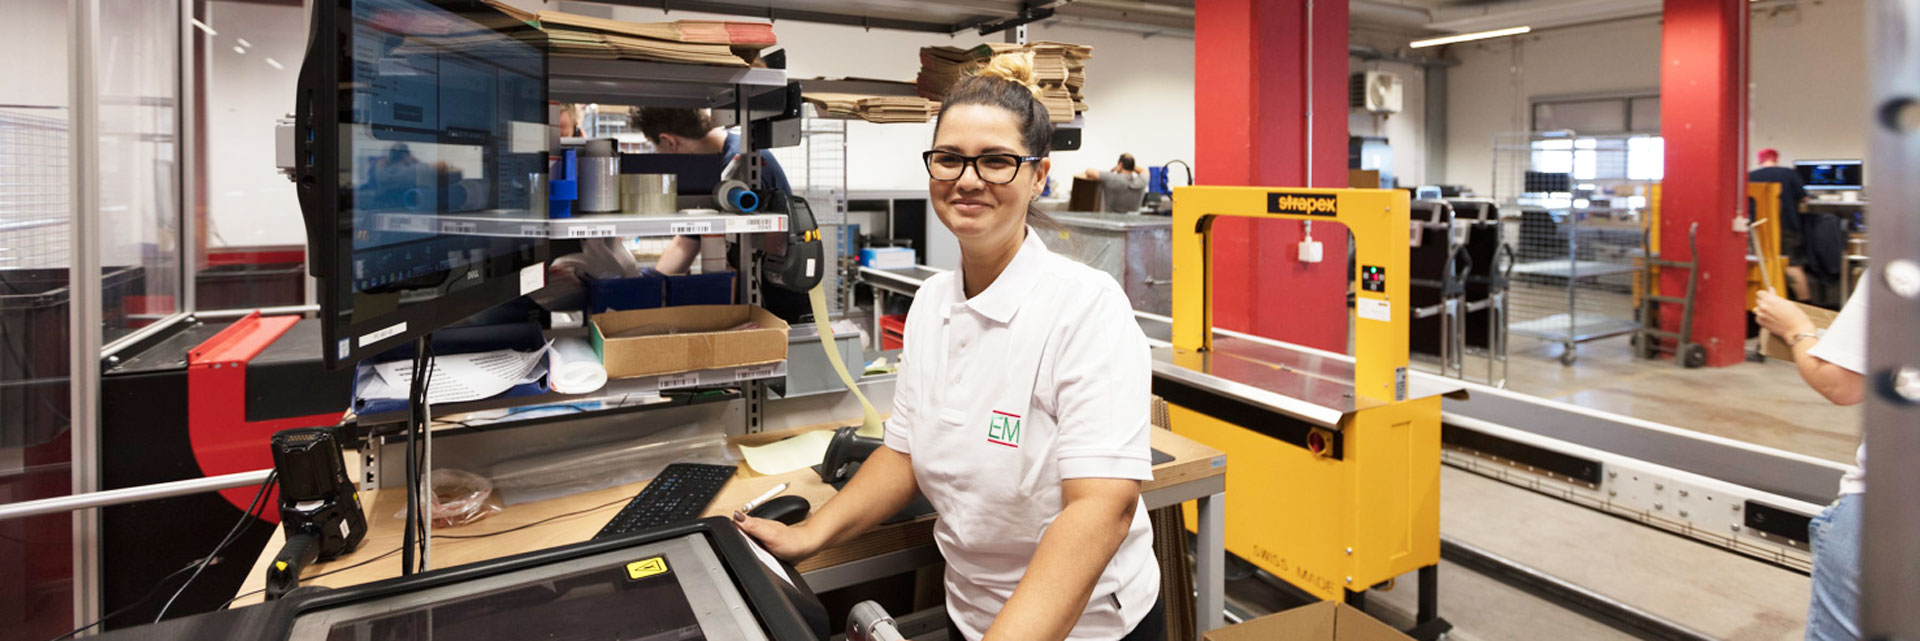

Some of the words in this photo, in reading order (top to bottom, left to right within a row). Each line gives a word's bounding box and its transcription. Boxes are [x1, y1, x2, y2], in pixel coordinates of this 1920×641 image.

[1278, 195, 1336, 214] strapex
[467, 269, 479, 280] DELL
[988, 415, 1020, 444] EM
[1253, 544, 1289, 572] SWISS
[1297, 565, 1335, 595] MADE
